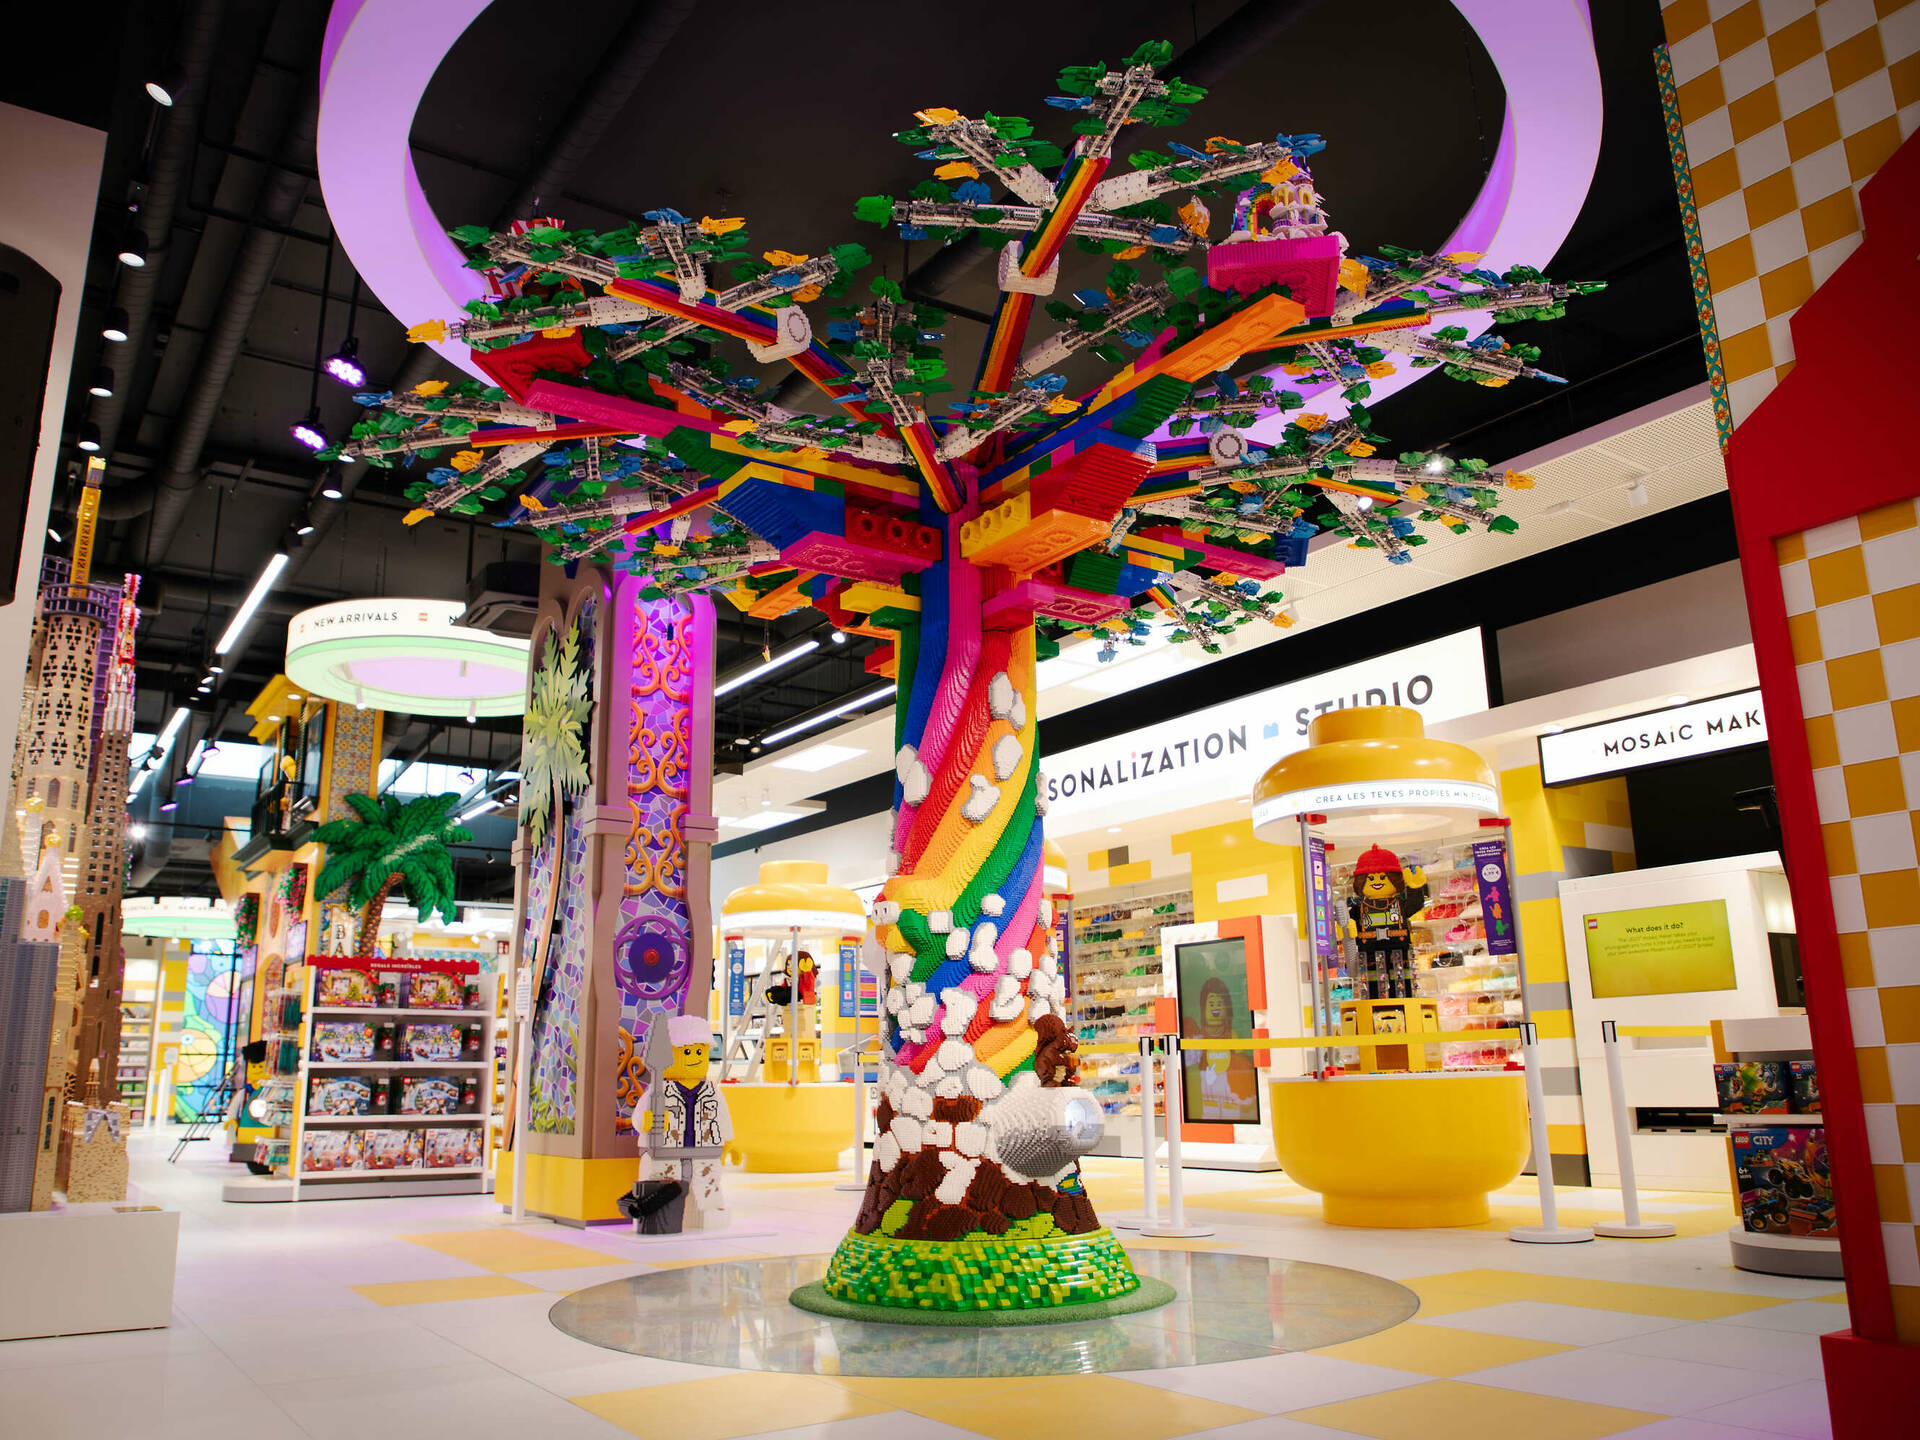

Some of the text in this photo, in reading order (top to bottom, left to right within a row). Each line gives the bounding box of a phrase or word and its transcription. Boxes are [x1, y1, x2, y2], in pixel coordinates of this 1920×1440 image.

[314, 611, 398, 628] NEW ARRIVALS
[1315, 794, 1342, 804] CREA
[1347, 792, 1366, 801] LES
[1370, 789, 1404, 799] TEVES
[1625, 925, 1644, 934] What
[1646, 924, 1662, 932] does
[1671, 921, 1684, 930] do?
[1752, 1135, 1775, 1146] CITY
